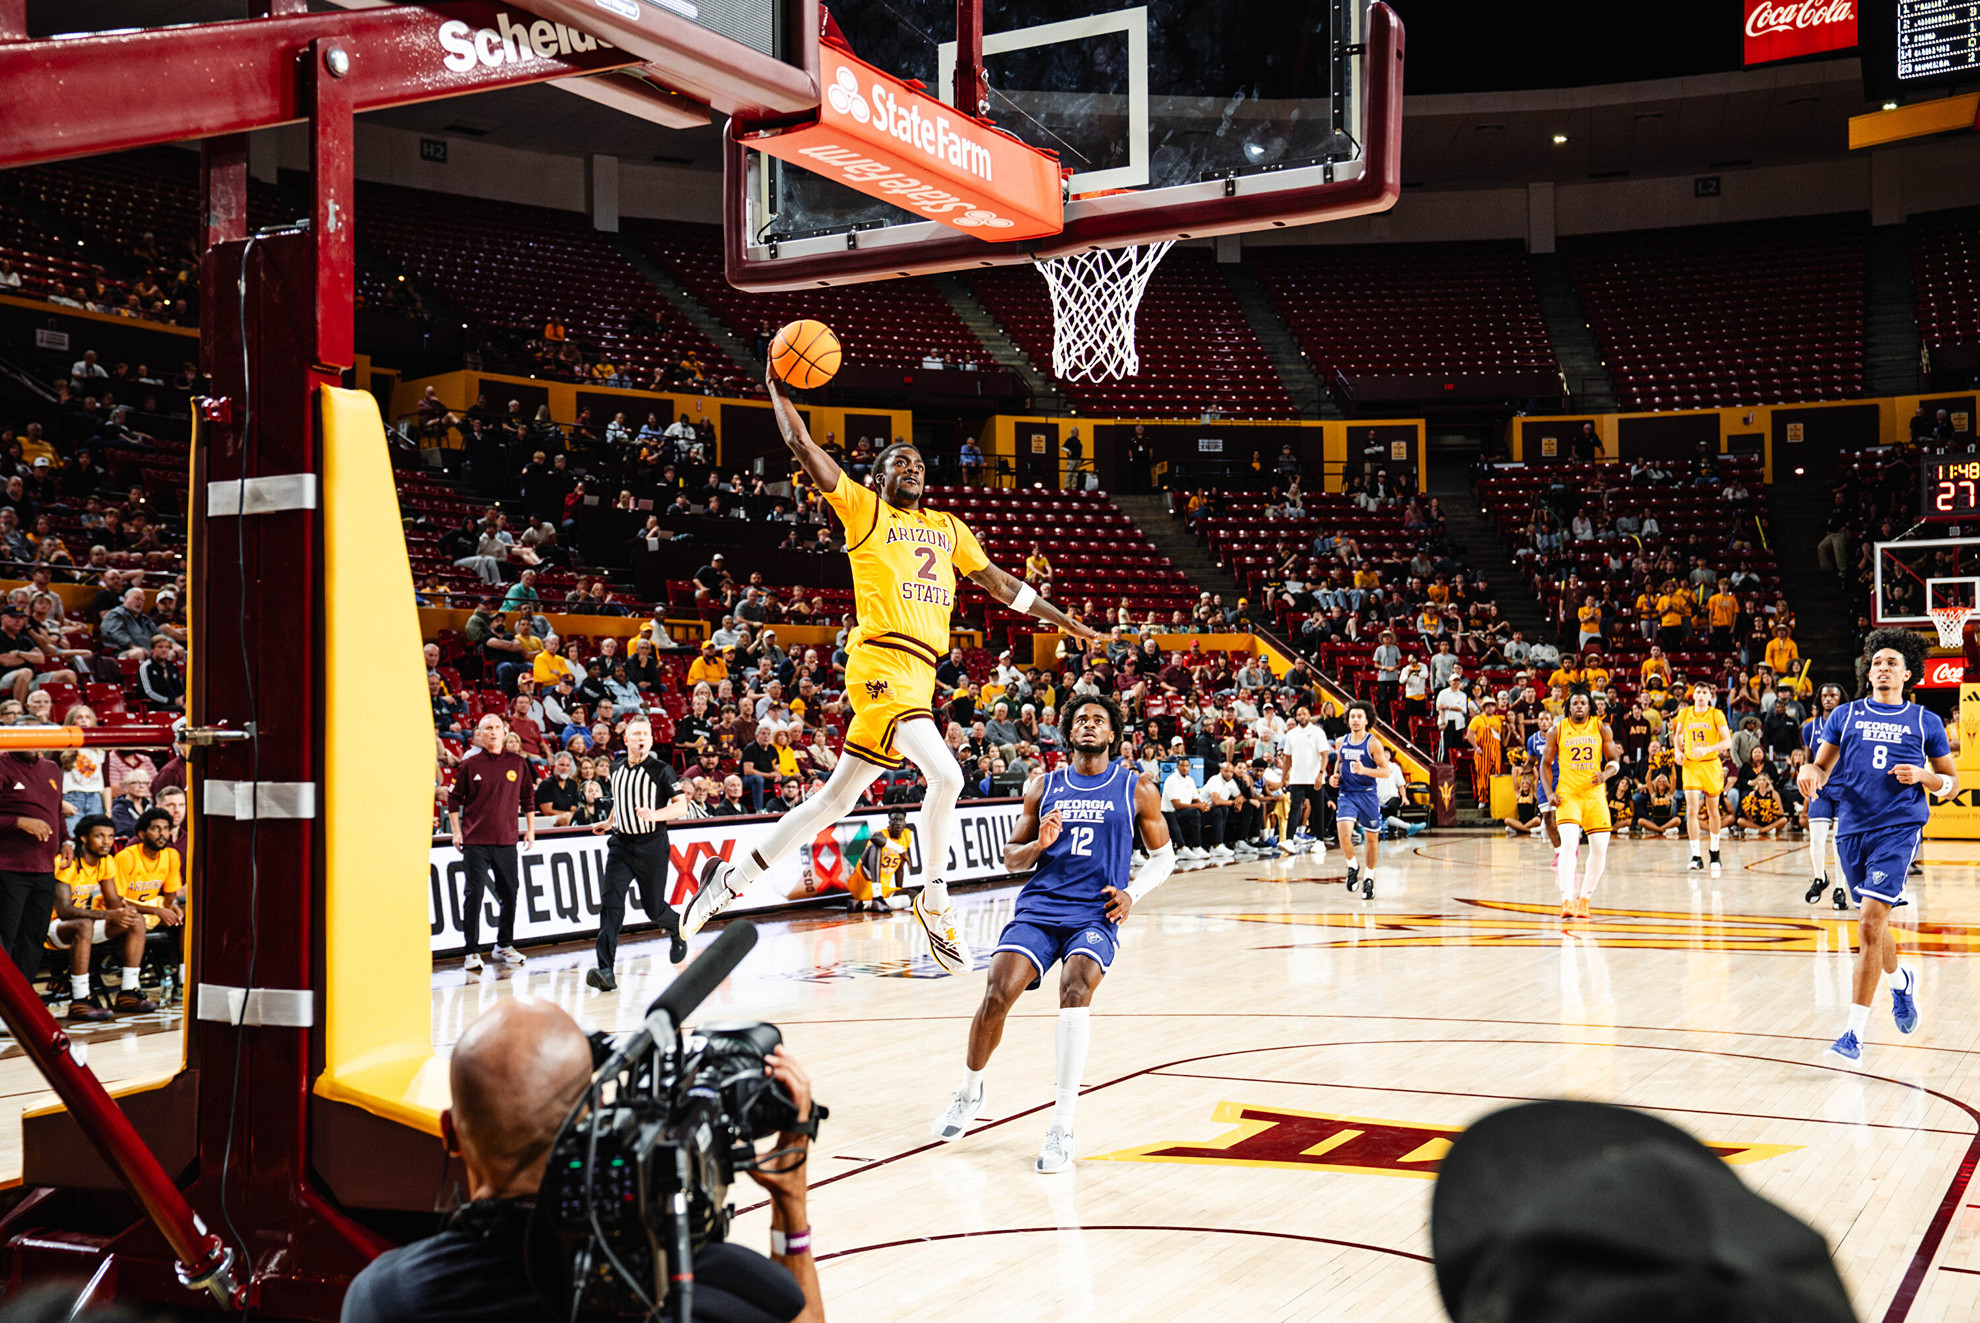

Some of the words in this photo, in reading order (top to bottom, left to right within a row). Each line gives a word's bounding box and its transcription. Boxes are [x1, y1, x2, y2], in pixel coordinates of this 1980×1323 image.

[423, 142, 446, 159] H2
[1698, 179, 1718, 194] L2
[1938, 461, 1980, 480] 11:48
[1936, 480, 1976, 511] 27
[914, 546, 937, 581] 2
[902, 582, 951, 607] STATE
[1629, 726, 1648, 735] ASU
[1854, 720, 1912, 735] GEORGIA
[1862, 729, 1903, 741] STATE
[1565, 735, 1598, 748] ARIZONA
[1692, 730, 1705, 741] 14
[1570, 746, 1593, 761] 23
[1872, 744, 1888, 770] 8
[1570, 762, 1595, 771] STATE
[1054, 799, 1115, 811] GEORGIA
[1061, 809, 1105, 820] STATE
[1070, 826, 1094, 857] 12
[881, 856, 901, 868] 35
